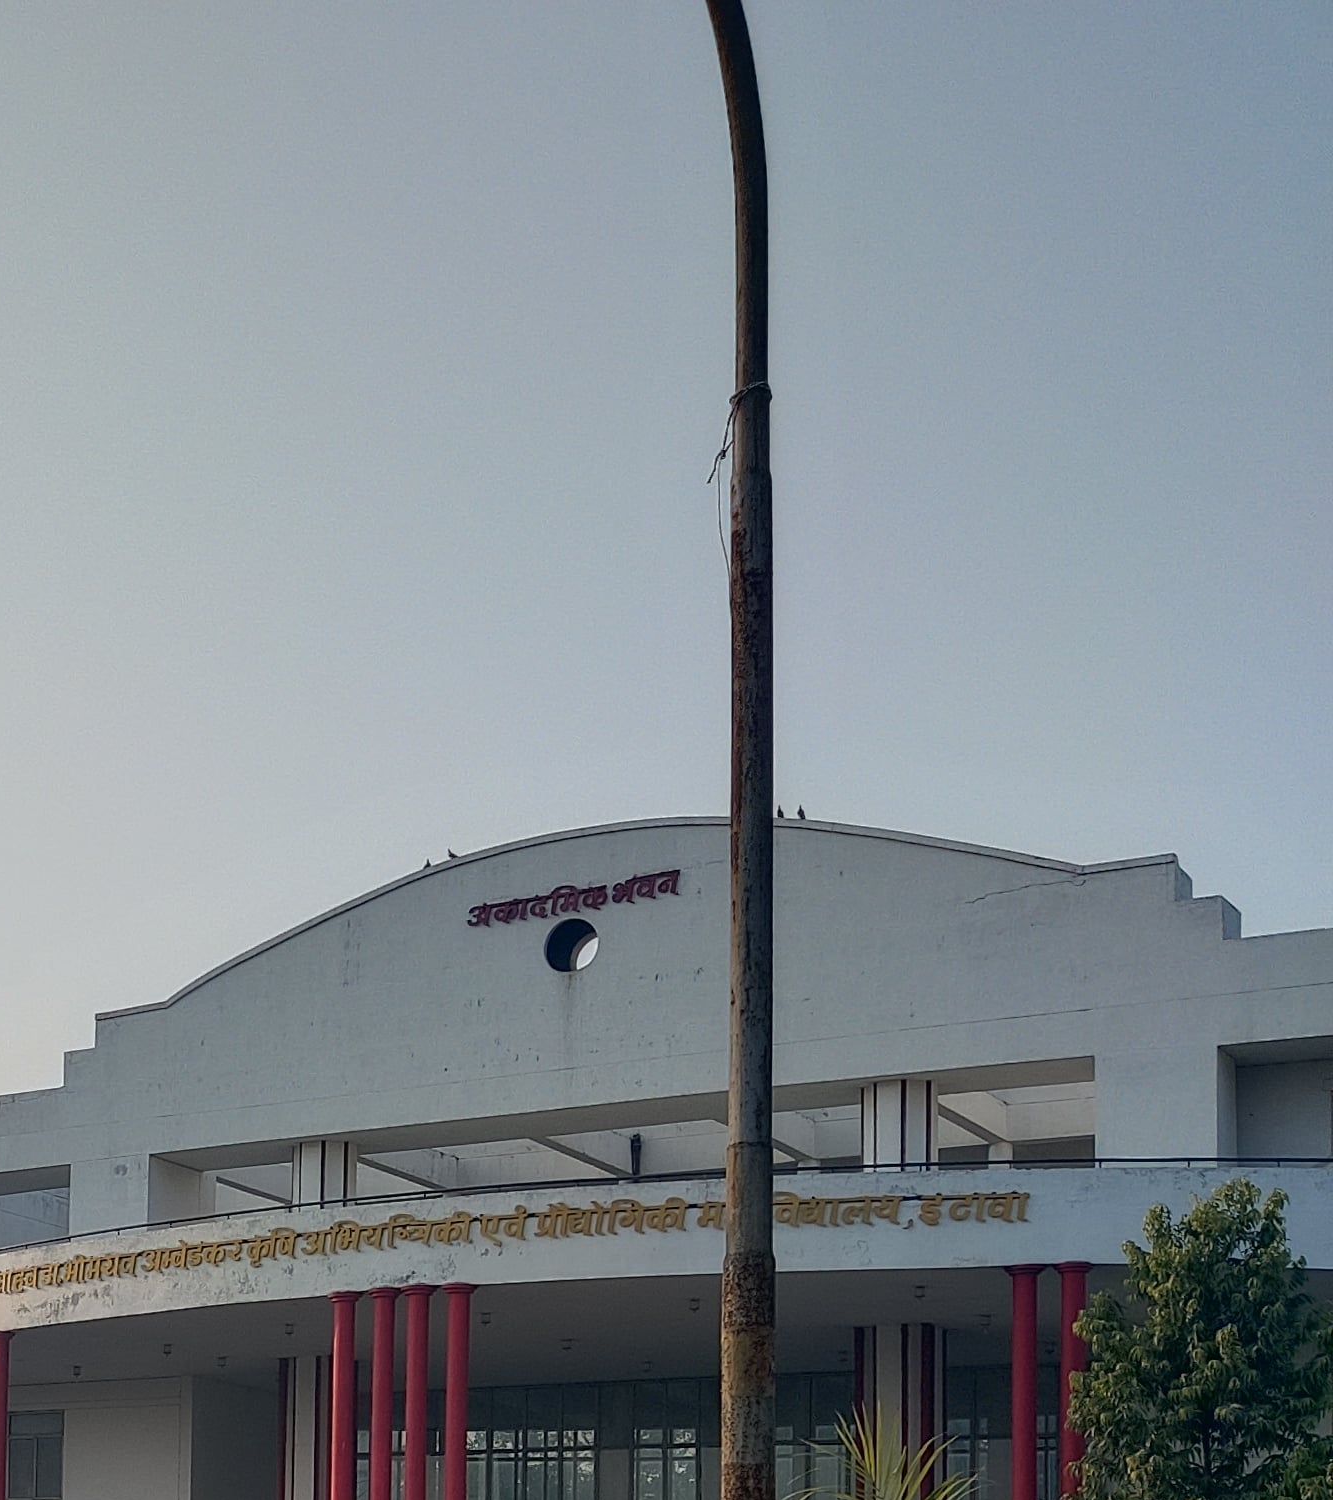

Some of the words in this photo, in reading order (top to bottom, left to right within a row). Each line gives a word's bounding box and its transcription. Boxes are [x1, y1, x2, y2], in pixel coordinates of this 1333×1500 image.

[612, 869, 681, 904] भवन
[248, 1227, 298, 1269] कृषि
[479, 1204, 527, 1247] एवं
[534, 1197, 687, 1240] प्रौद्योगिकी
[918, 1191, 1031, 1226] इटावा
